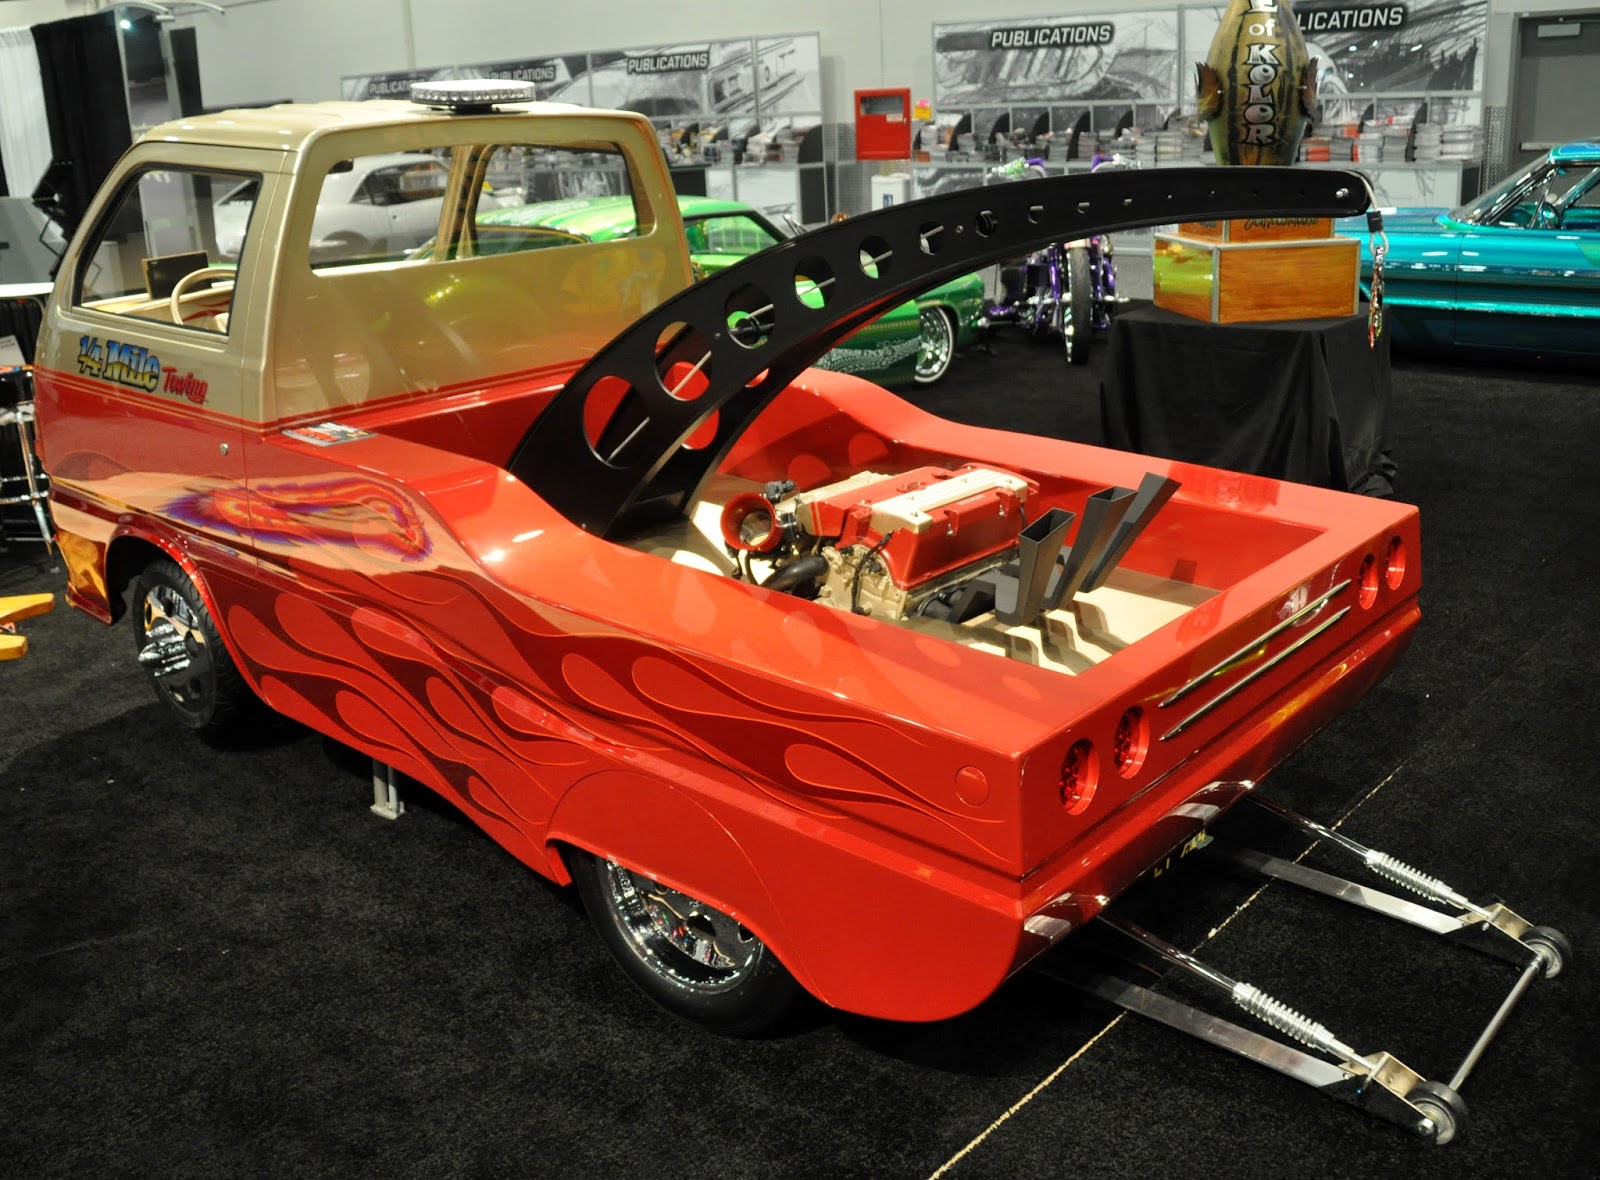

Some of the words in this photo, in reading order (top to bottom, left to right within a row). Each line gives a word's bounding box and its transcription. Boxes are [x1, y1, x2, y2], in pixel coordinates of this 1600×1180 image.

[1249, 19, 1276, 36] of
[1297, 7, 1404, 31] LICATIONS
[991, 24, 1112, 48] PUBLICATIONS
[628, 53, 709, 72] PUBLICATIONS
[369, 79, 426, 94] PUBLICATI
[1243, 43, 1281, 145] KOLOR
[102, 340, 160, 393] Mile
[161, 365, 209, 405] Towing
